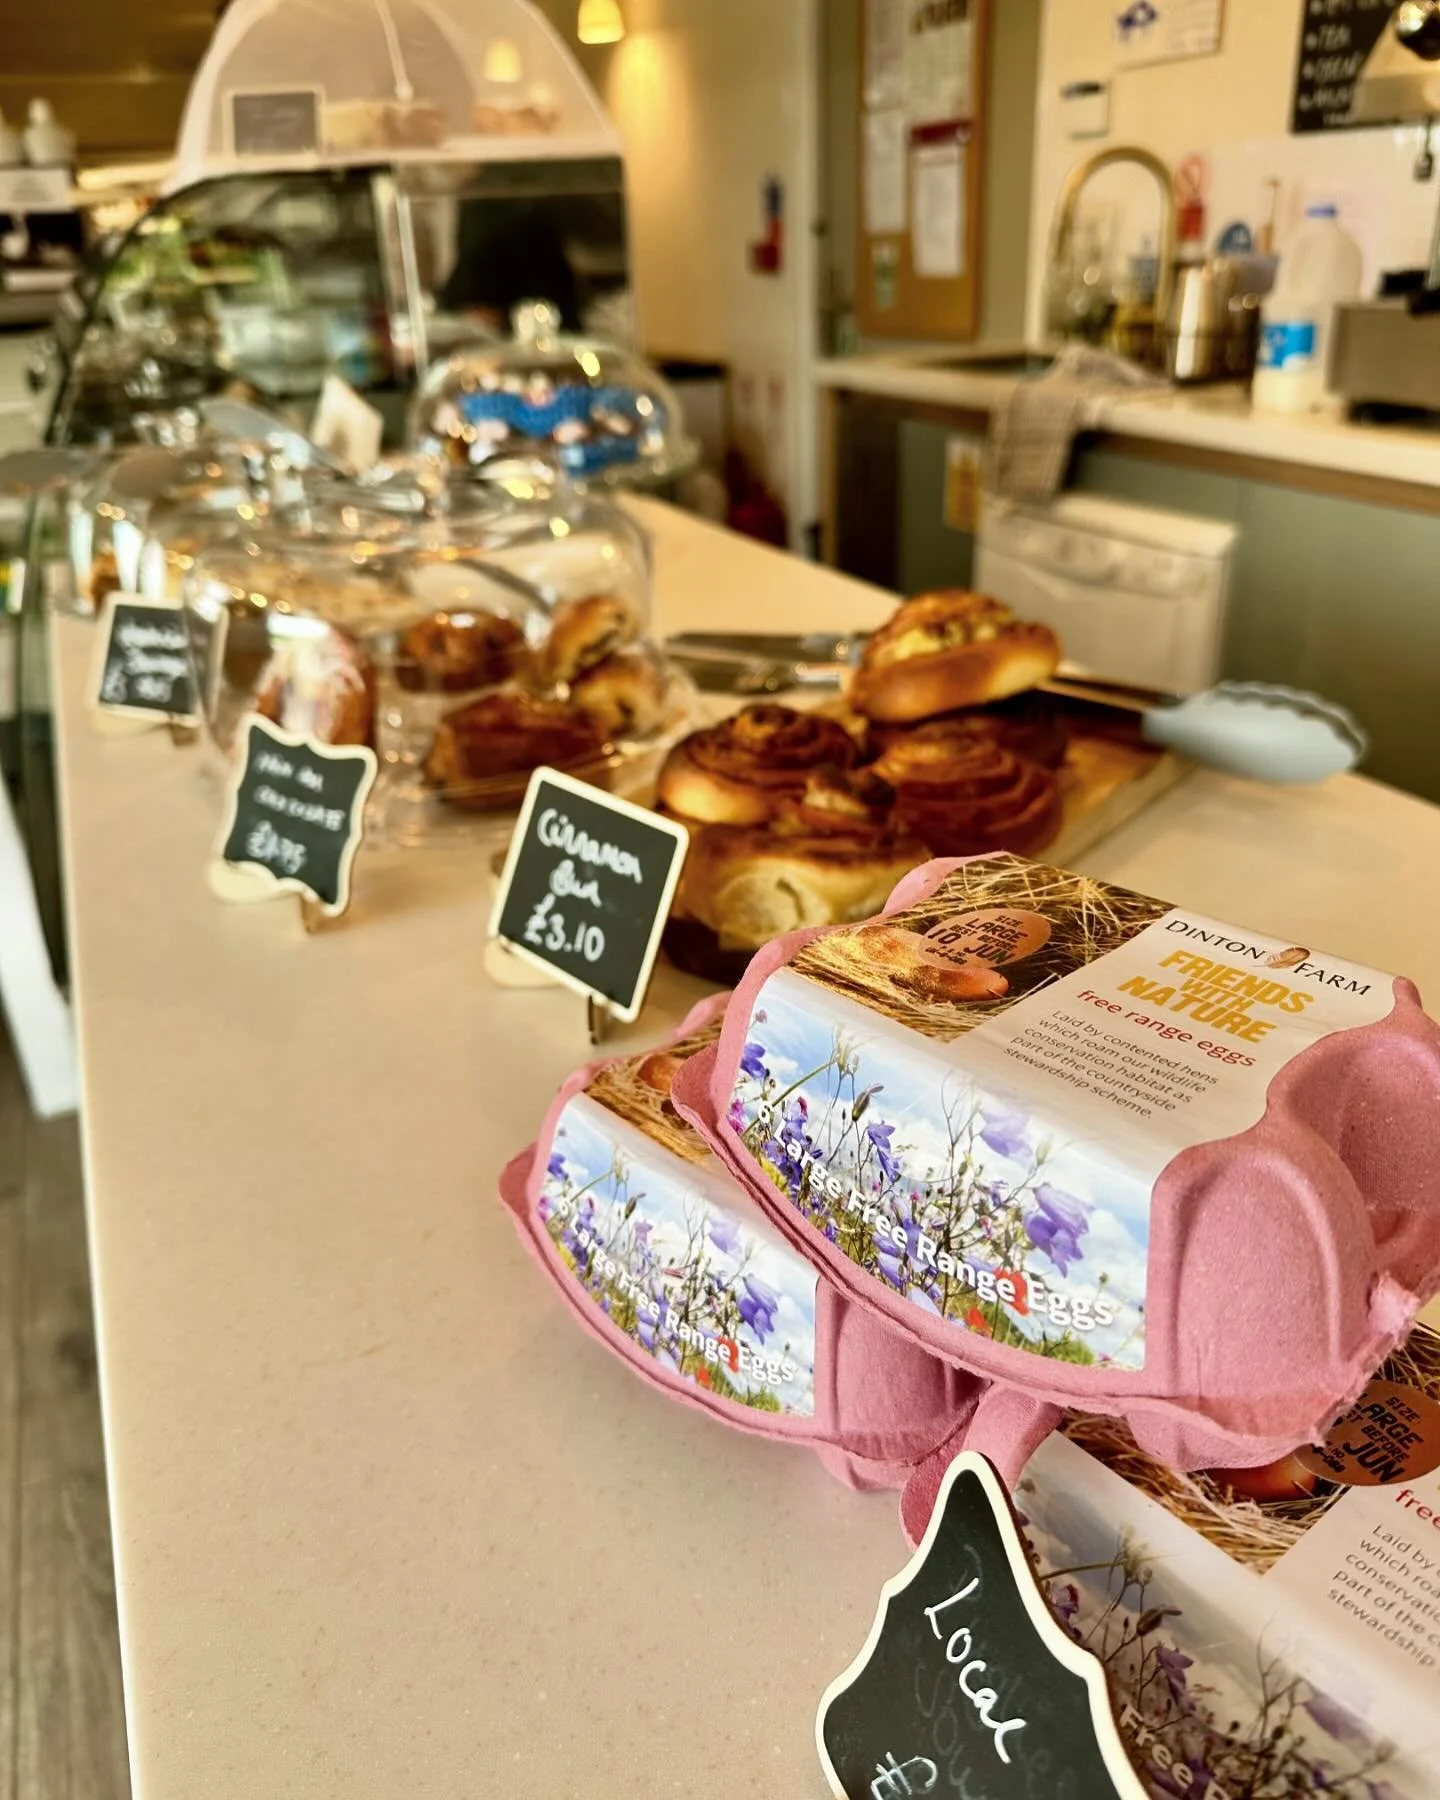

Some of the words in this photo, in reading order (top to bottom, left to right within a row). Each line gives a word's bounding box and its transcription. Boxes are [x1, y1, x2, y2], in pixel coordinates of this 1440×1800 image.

[523, 893, 605, 962] £3.10
[928, 928, 962, 944] 10
[963, 944, 1016, 964] JUN
[949, 924, 978, 937] BEST
[965, 918, 1028, 943] LARGE
[1165, 920, 1266, 960] DINTON
[1293, 962, 1371, 995] FARM
[1117, 976, 1278, 1043] NATURE
[1159, 949, 1314, 1013] FRIENDS
[1180, 977, 1255, 1012] WITH
[1039, 1018, 1079, 1041] which
[1081, 1038, 1120, 1059] roam
[1122, 1054, 1150, 1070] our
[1150, 1066, 1207, 1093] wildlife
[1052, 1010, 1083, 1027] Laid
[1083, 1023, 1104, 1037] by
[1103, 1033, 1180, 1068] contented
[1179, 1064, 1219, 1085] hens
[1077, 990, 1122, 1015] free
[1124, 1010, 1193, 1042] range
[1197, 1040, 1257, 1067] eggs
[1004, 1047, 1089, 1088] stewardship
[1090, 1085, 1152, 1118] scheme.
[1010, 1036, 1043, 1054] part
[1044, 1048, 1062, 1062] of
[1060, 1054, 1086, 1071] the
[1087, 1068, 1176, 1112] countryside
[1024, 1028, 1114, 1070] conservation
[1116, 1067, 1173, 1095] habitat
[1173, 1090, 1193, 1103] as
[757, 1102, 774, 1124] 6
[773, 1118, 842, 1199] Large
[848, 1189, 908, 1249] Free
[916, 1231, 1016, 1303] Range
[1026, 1277, 1114, 1331] Eggs
[619, 1270, 660, 1318] Free
[666, 1312, 731, 1362] Range
[738, 1342, 795, 1385] Eggs
[1342, 1441, 1406, 1482] JUN
[1361, 1424, 1410, 1463] BEFORE
[1360, 1538, 1410, 1577] which
[1413, 1574, 1440, 1598] roa
[1372, 1524, 1412, 1554] Laid
[1411, 1549, 1436, 1570] by
[1332, 1569, 1373, 1599] part
[1374, 1596, 1396, 1613] of
[1395, 1609, 1426, 1634] the
[1345, 1553, 1440, 1625] conservati
[1328, 1587, 1436, 1667] stewardship
[923, 1577, 1028, 1764] Local
[1120, 1703, 1193, 1789] Free
